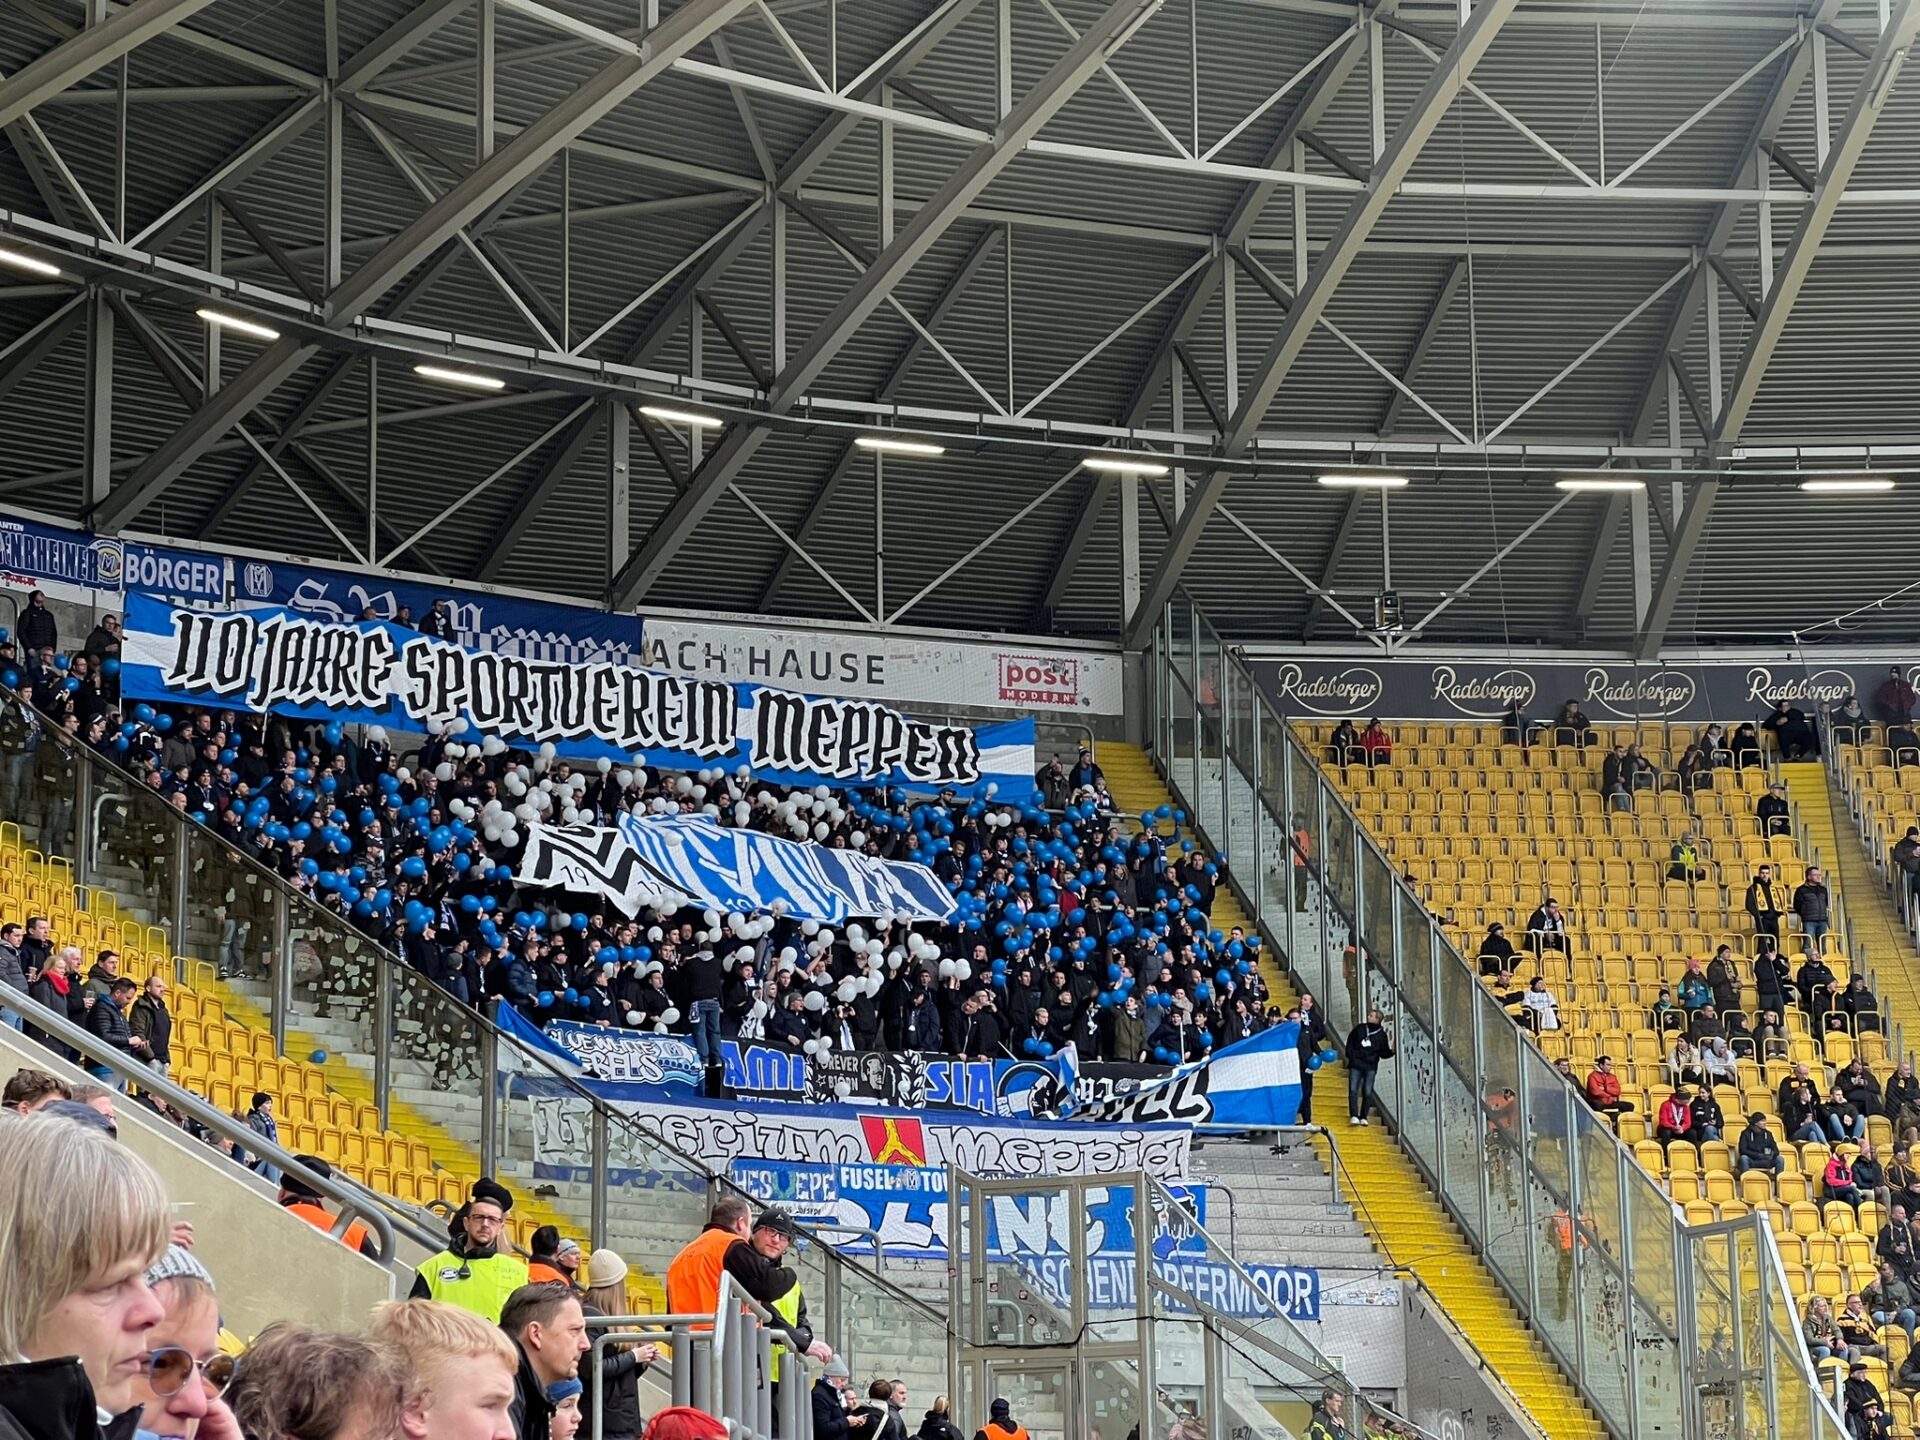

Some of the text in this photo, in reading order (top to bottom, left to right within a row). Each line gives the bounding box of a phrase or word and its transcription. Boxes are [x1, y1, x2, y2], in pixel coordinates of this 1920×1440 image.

[125, 548, 221, 595] BÖRGER
[168, 613, 258, 697] 110
[252, 620, 393, 706] JAHRE
[748, 646, 885, 685] HAUSE
[1006, 690, 1070, 703] MODERN
[1277, 664, 1380, 708] Radeberger
[1431, 666, 1533, 709] Radeberger
[1584, 667, 1692, 709] Radeberger
[1745, 667, 1852, 706] Radeberger
[815, 1054, 859, 1072] REVER
[840, 1166, 893, 1191] FUSEL
